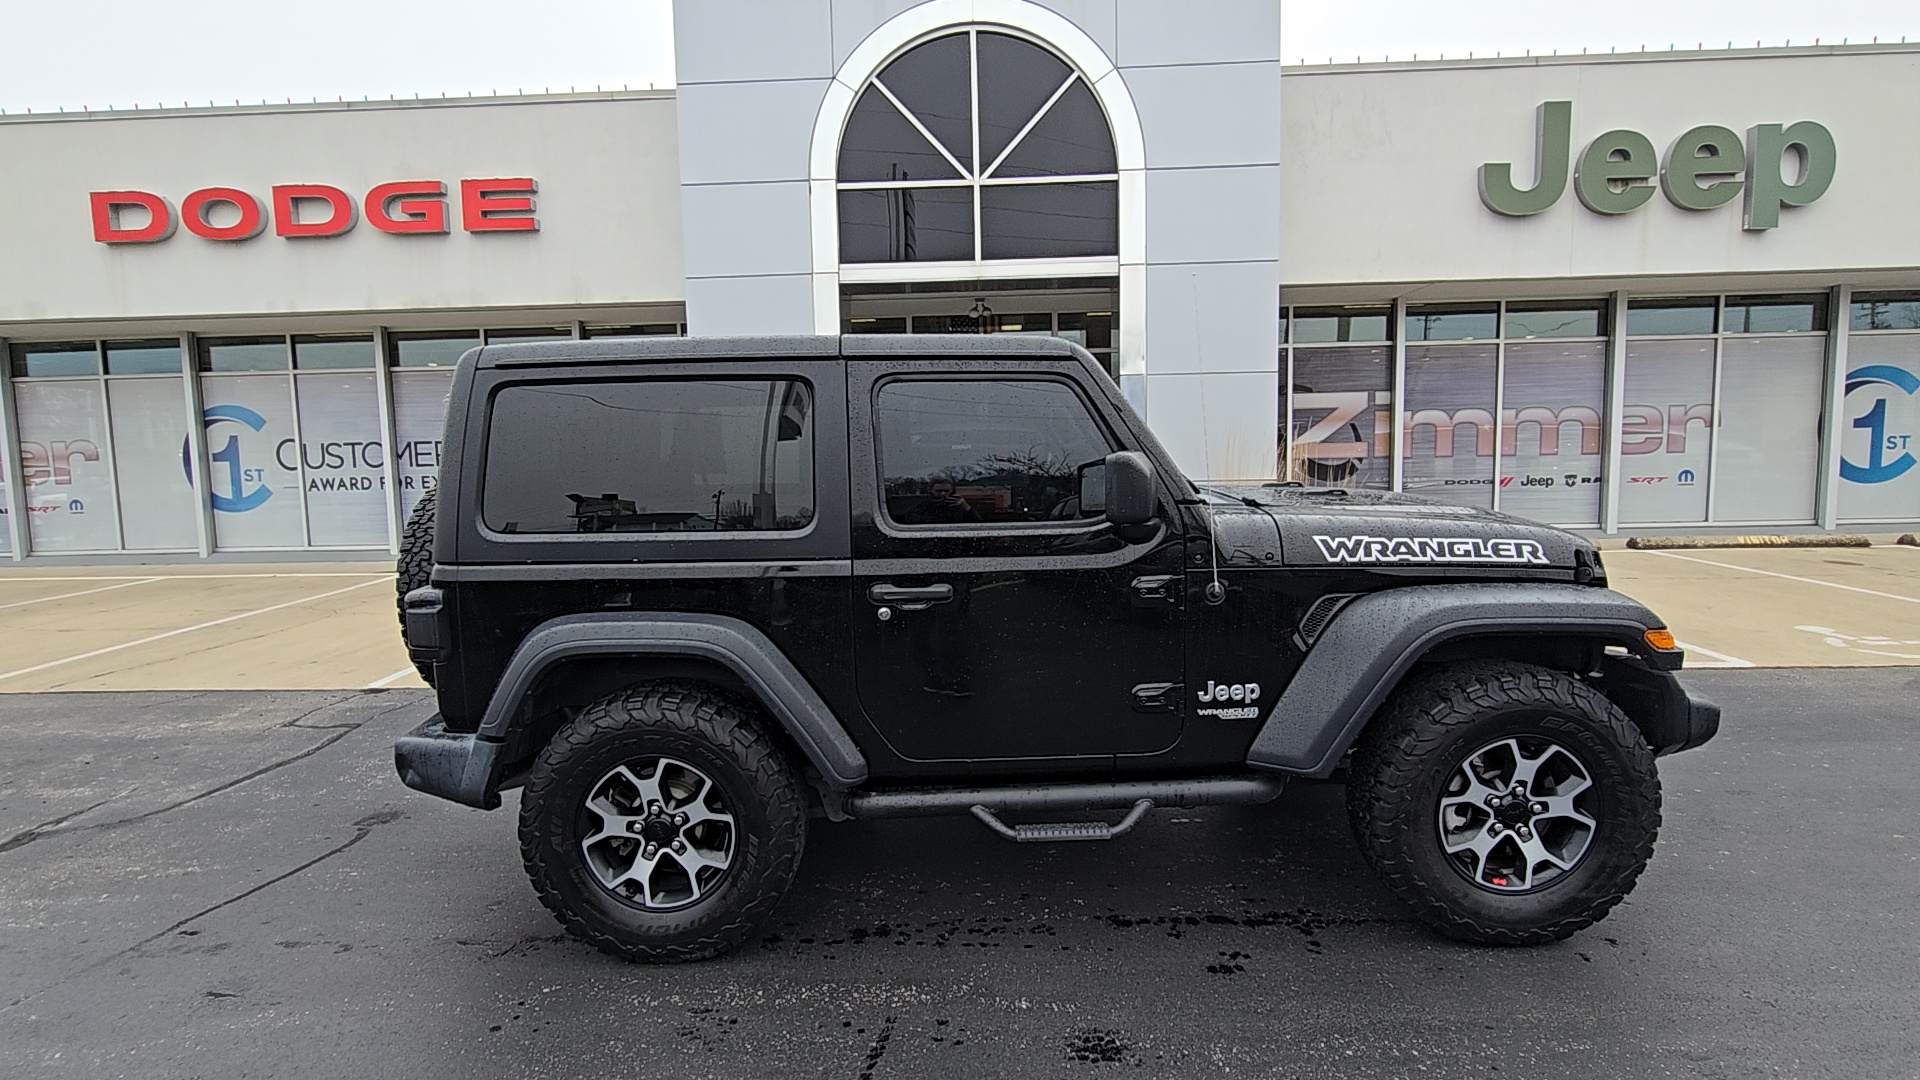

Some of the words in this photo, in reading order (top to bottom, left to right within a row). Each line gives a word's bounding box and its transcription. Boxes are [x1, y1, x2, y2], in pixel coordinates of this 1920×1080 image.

[1476, 100, 1837, 232] Jeep
[89, 177, 541, 245] DODGE
[1292, 390, 1723, 458] Zimmer
[0, 439, 100, 486] er
[308, 476, 373, 492] AWARD
[380, 475, 416, 490] FR
[1520, 475, 1555, 488] Jeep
[1580, 476, 1602, 484] RA
[1626, 476, 1669, 485] SRT
[28, 505, 61, 514] SRT
[1312, 535, 1551, 564] WRANGLER
[1737, 535, 1790, 545] VISITOR
[1196, 680, 1261, 704] Jeep
